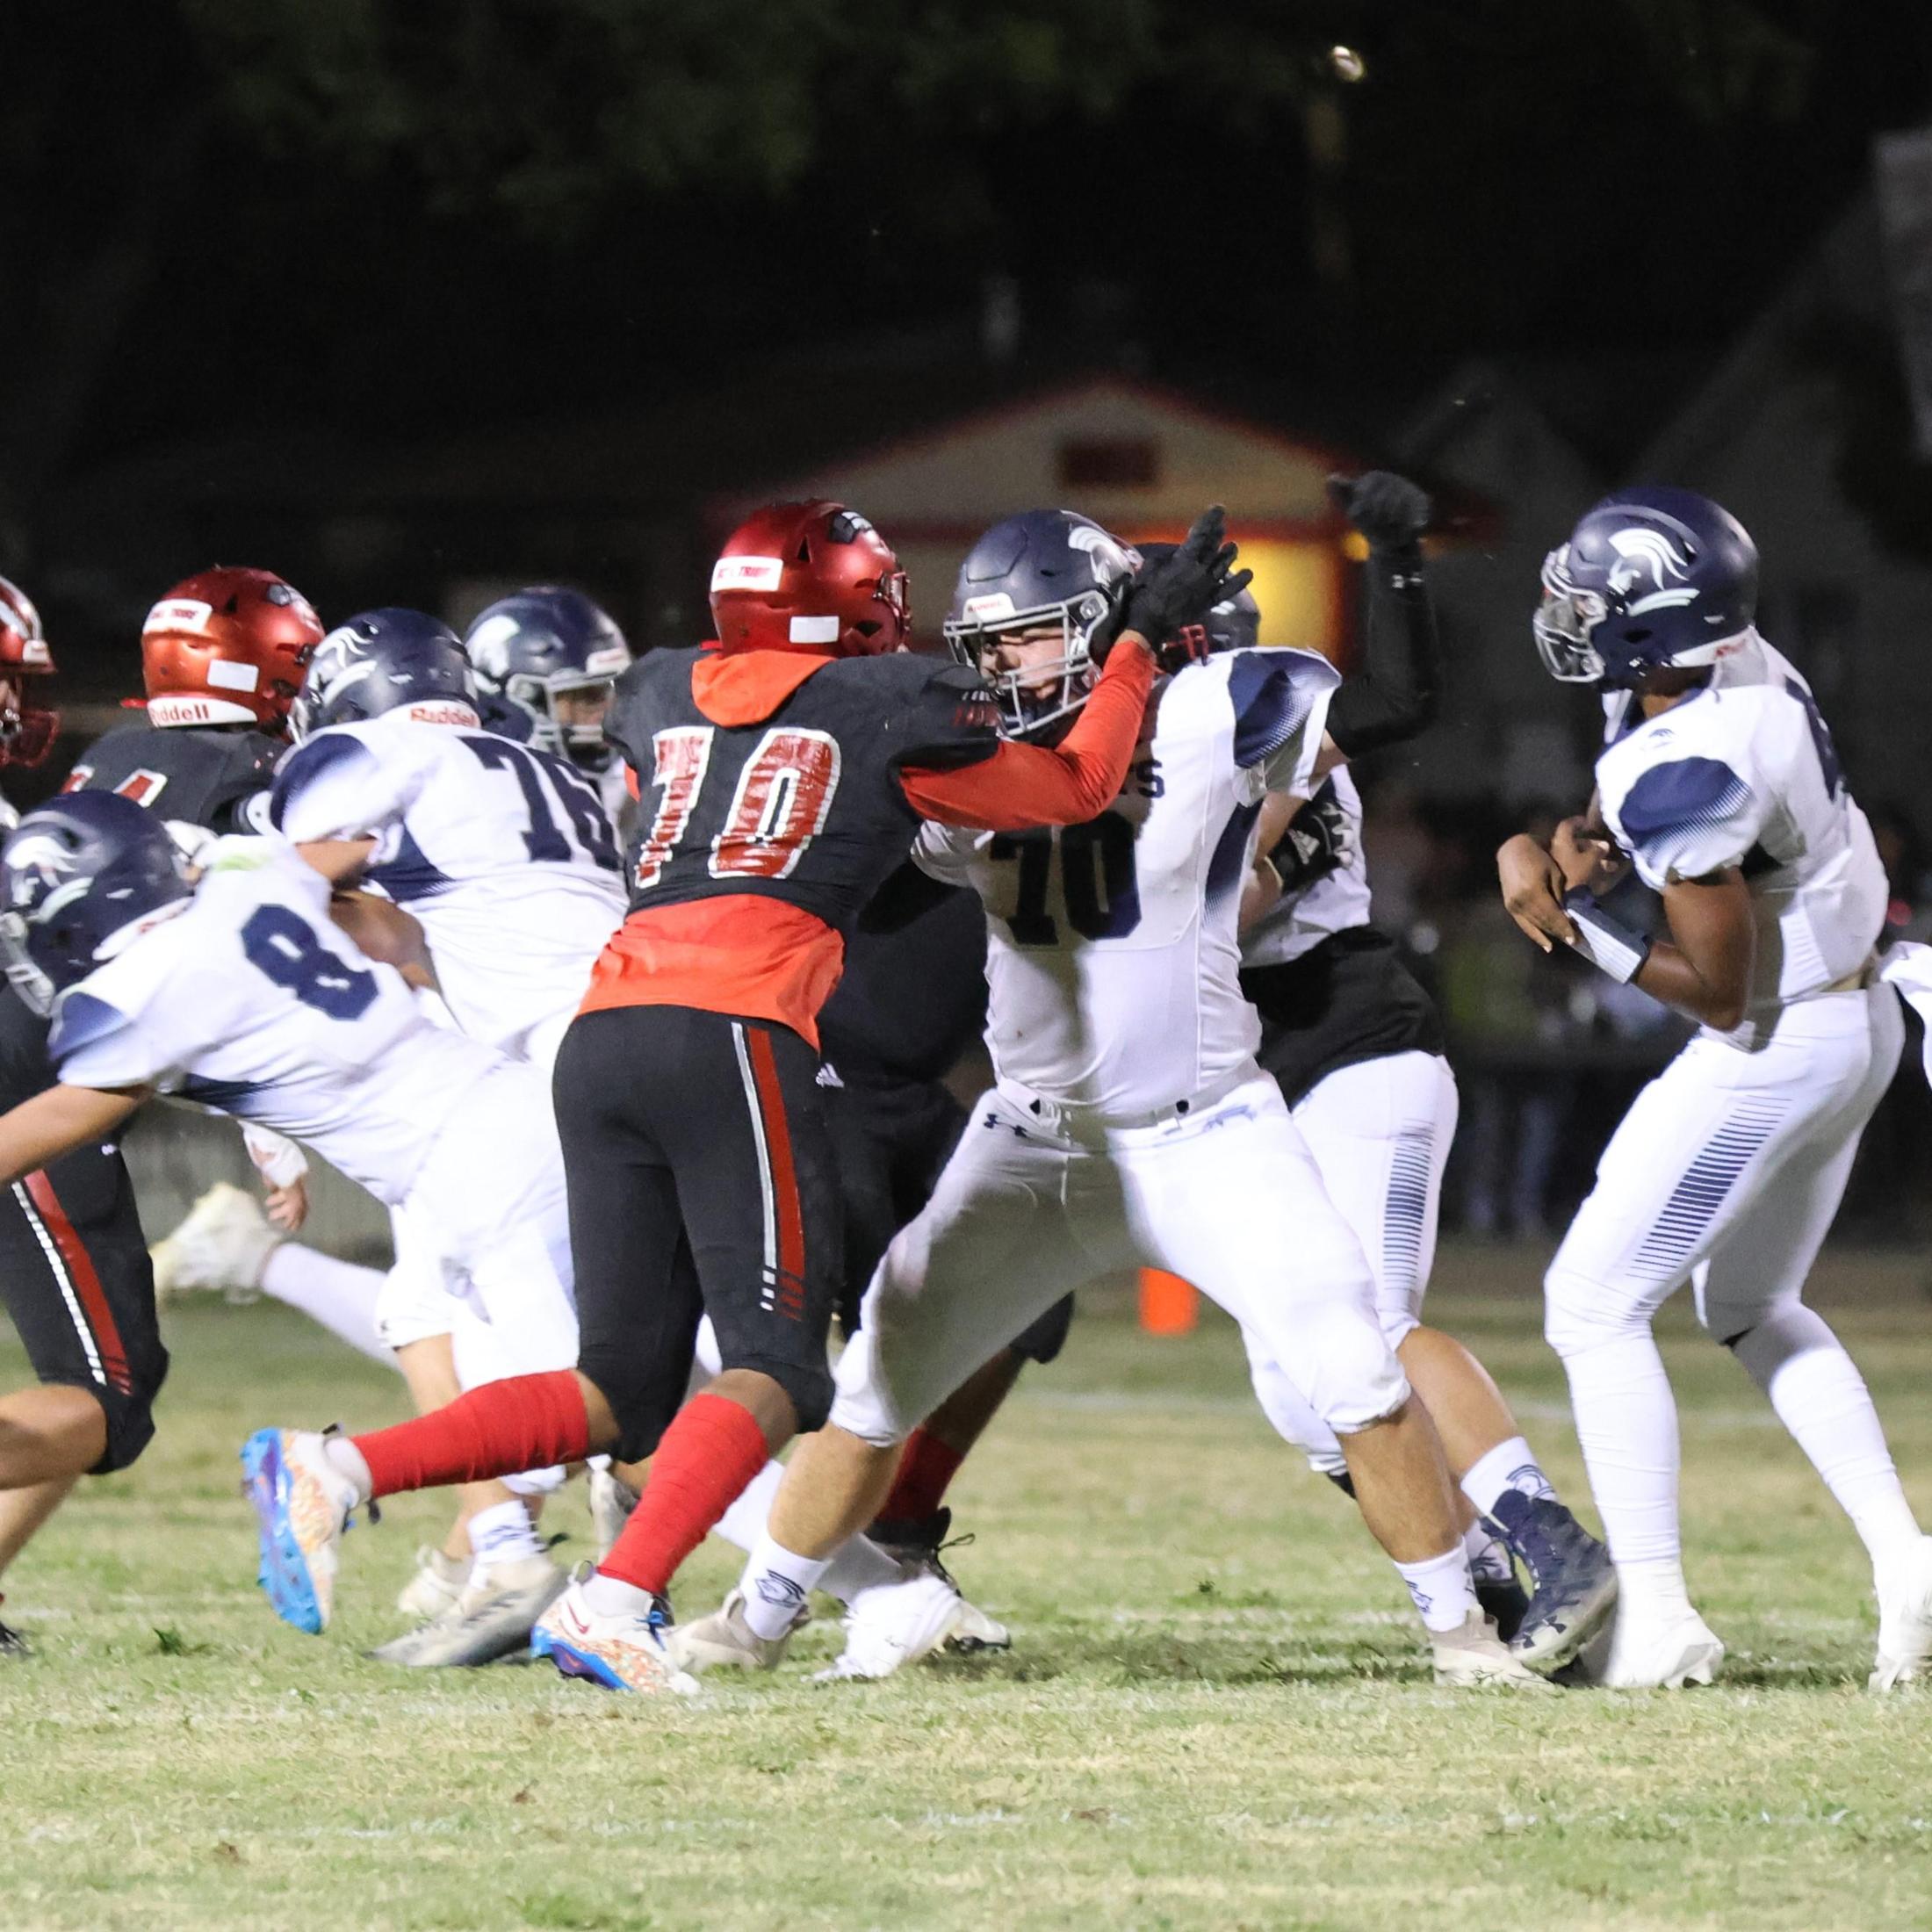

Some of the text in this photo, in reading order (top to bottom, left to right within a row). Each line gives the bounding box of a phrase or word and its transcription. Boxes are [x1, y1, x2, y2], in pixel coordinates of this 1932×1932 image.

[454, 736, 624, 872] 76
[635, 726, 841, 889] 10
[990, 810, 1142, 945] 70
[241, 904, 379, 1020] 8
